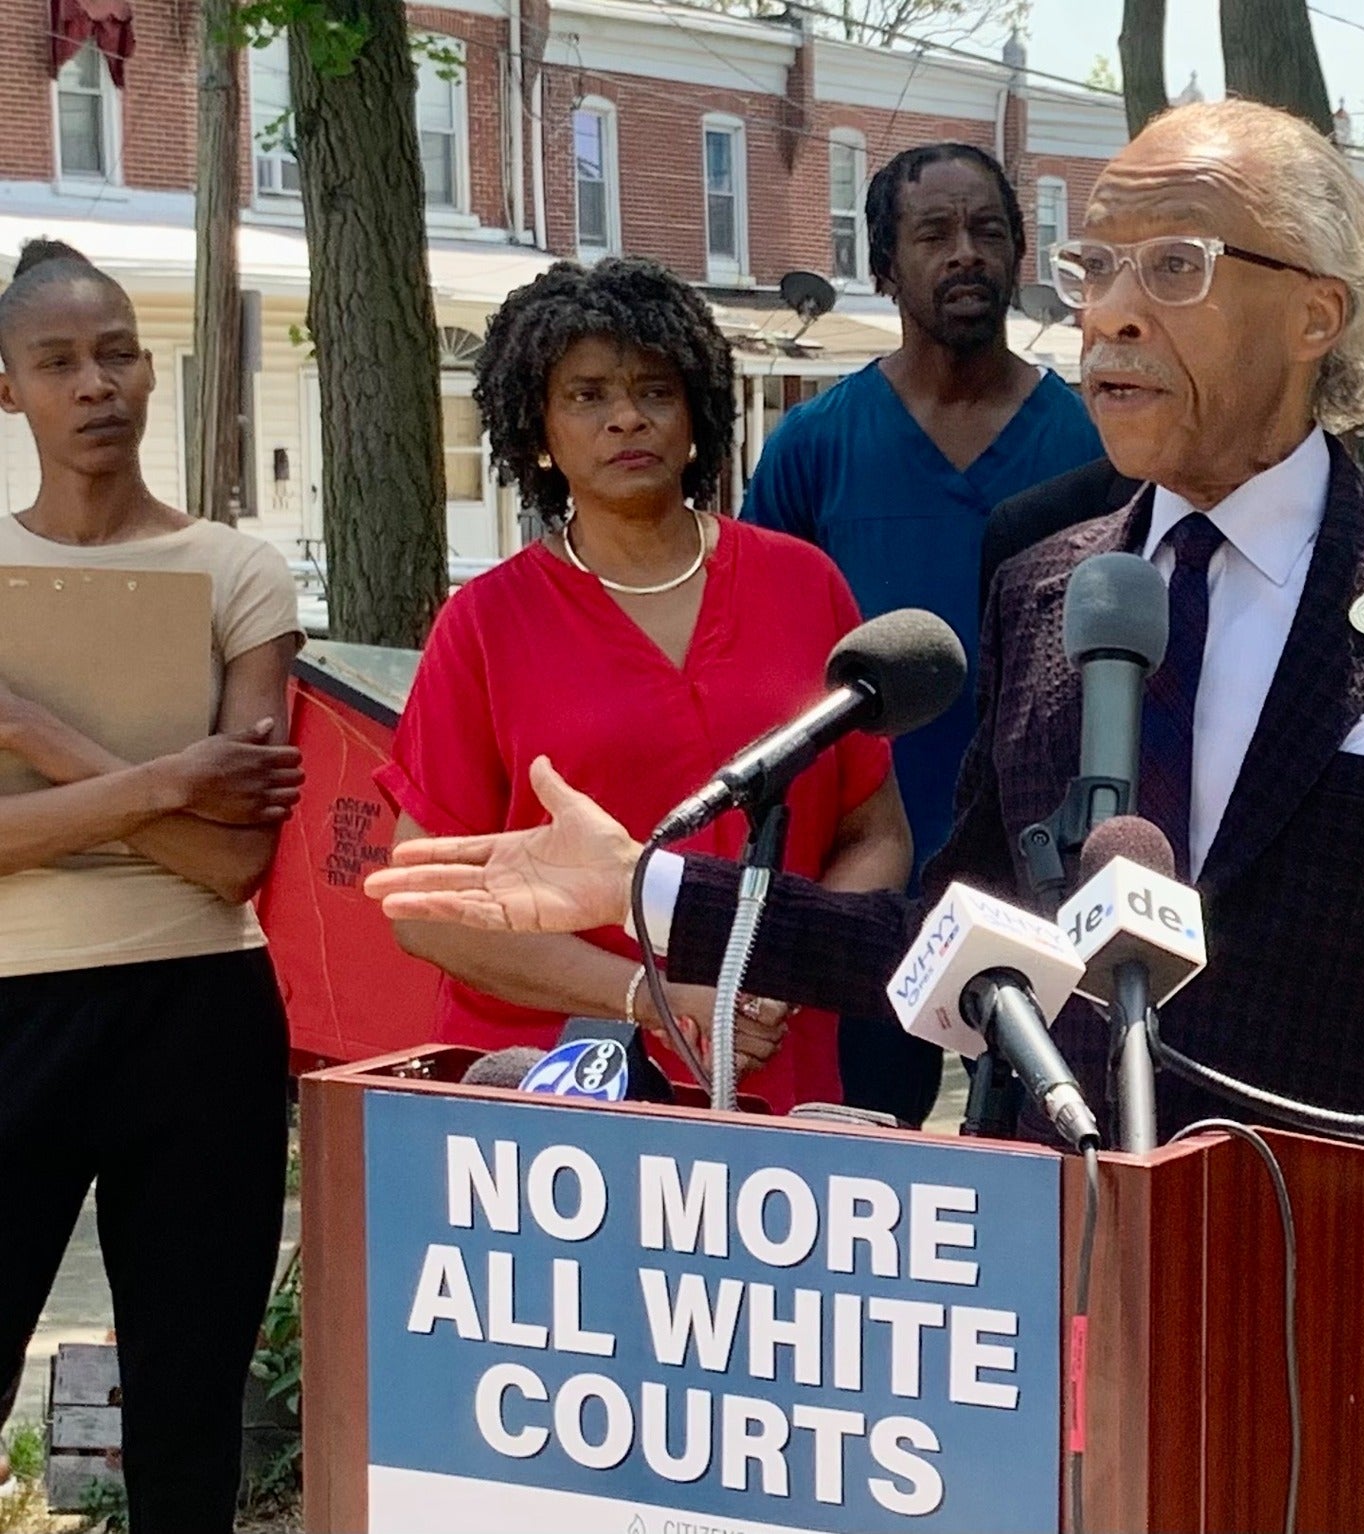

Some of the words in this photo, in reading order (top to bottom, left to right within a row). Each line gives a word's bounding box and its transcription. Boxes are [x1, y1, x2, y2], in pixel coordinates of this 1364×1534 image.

[896, 902, 956, 999] WHYY
[584, 1042, 616, 1090] abc
[446, 1134, 608, 1242] NO
[639, 1153, 980, 1287] MORE
[406, 1243, 616, 1358] ALL
[638, 1267, 1019, 1409] WHITE
[474, 1362, 944, 1518] COURTS
